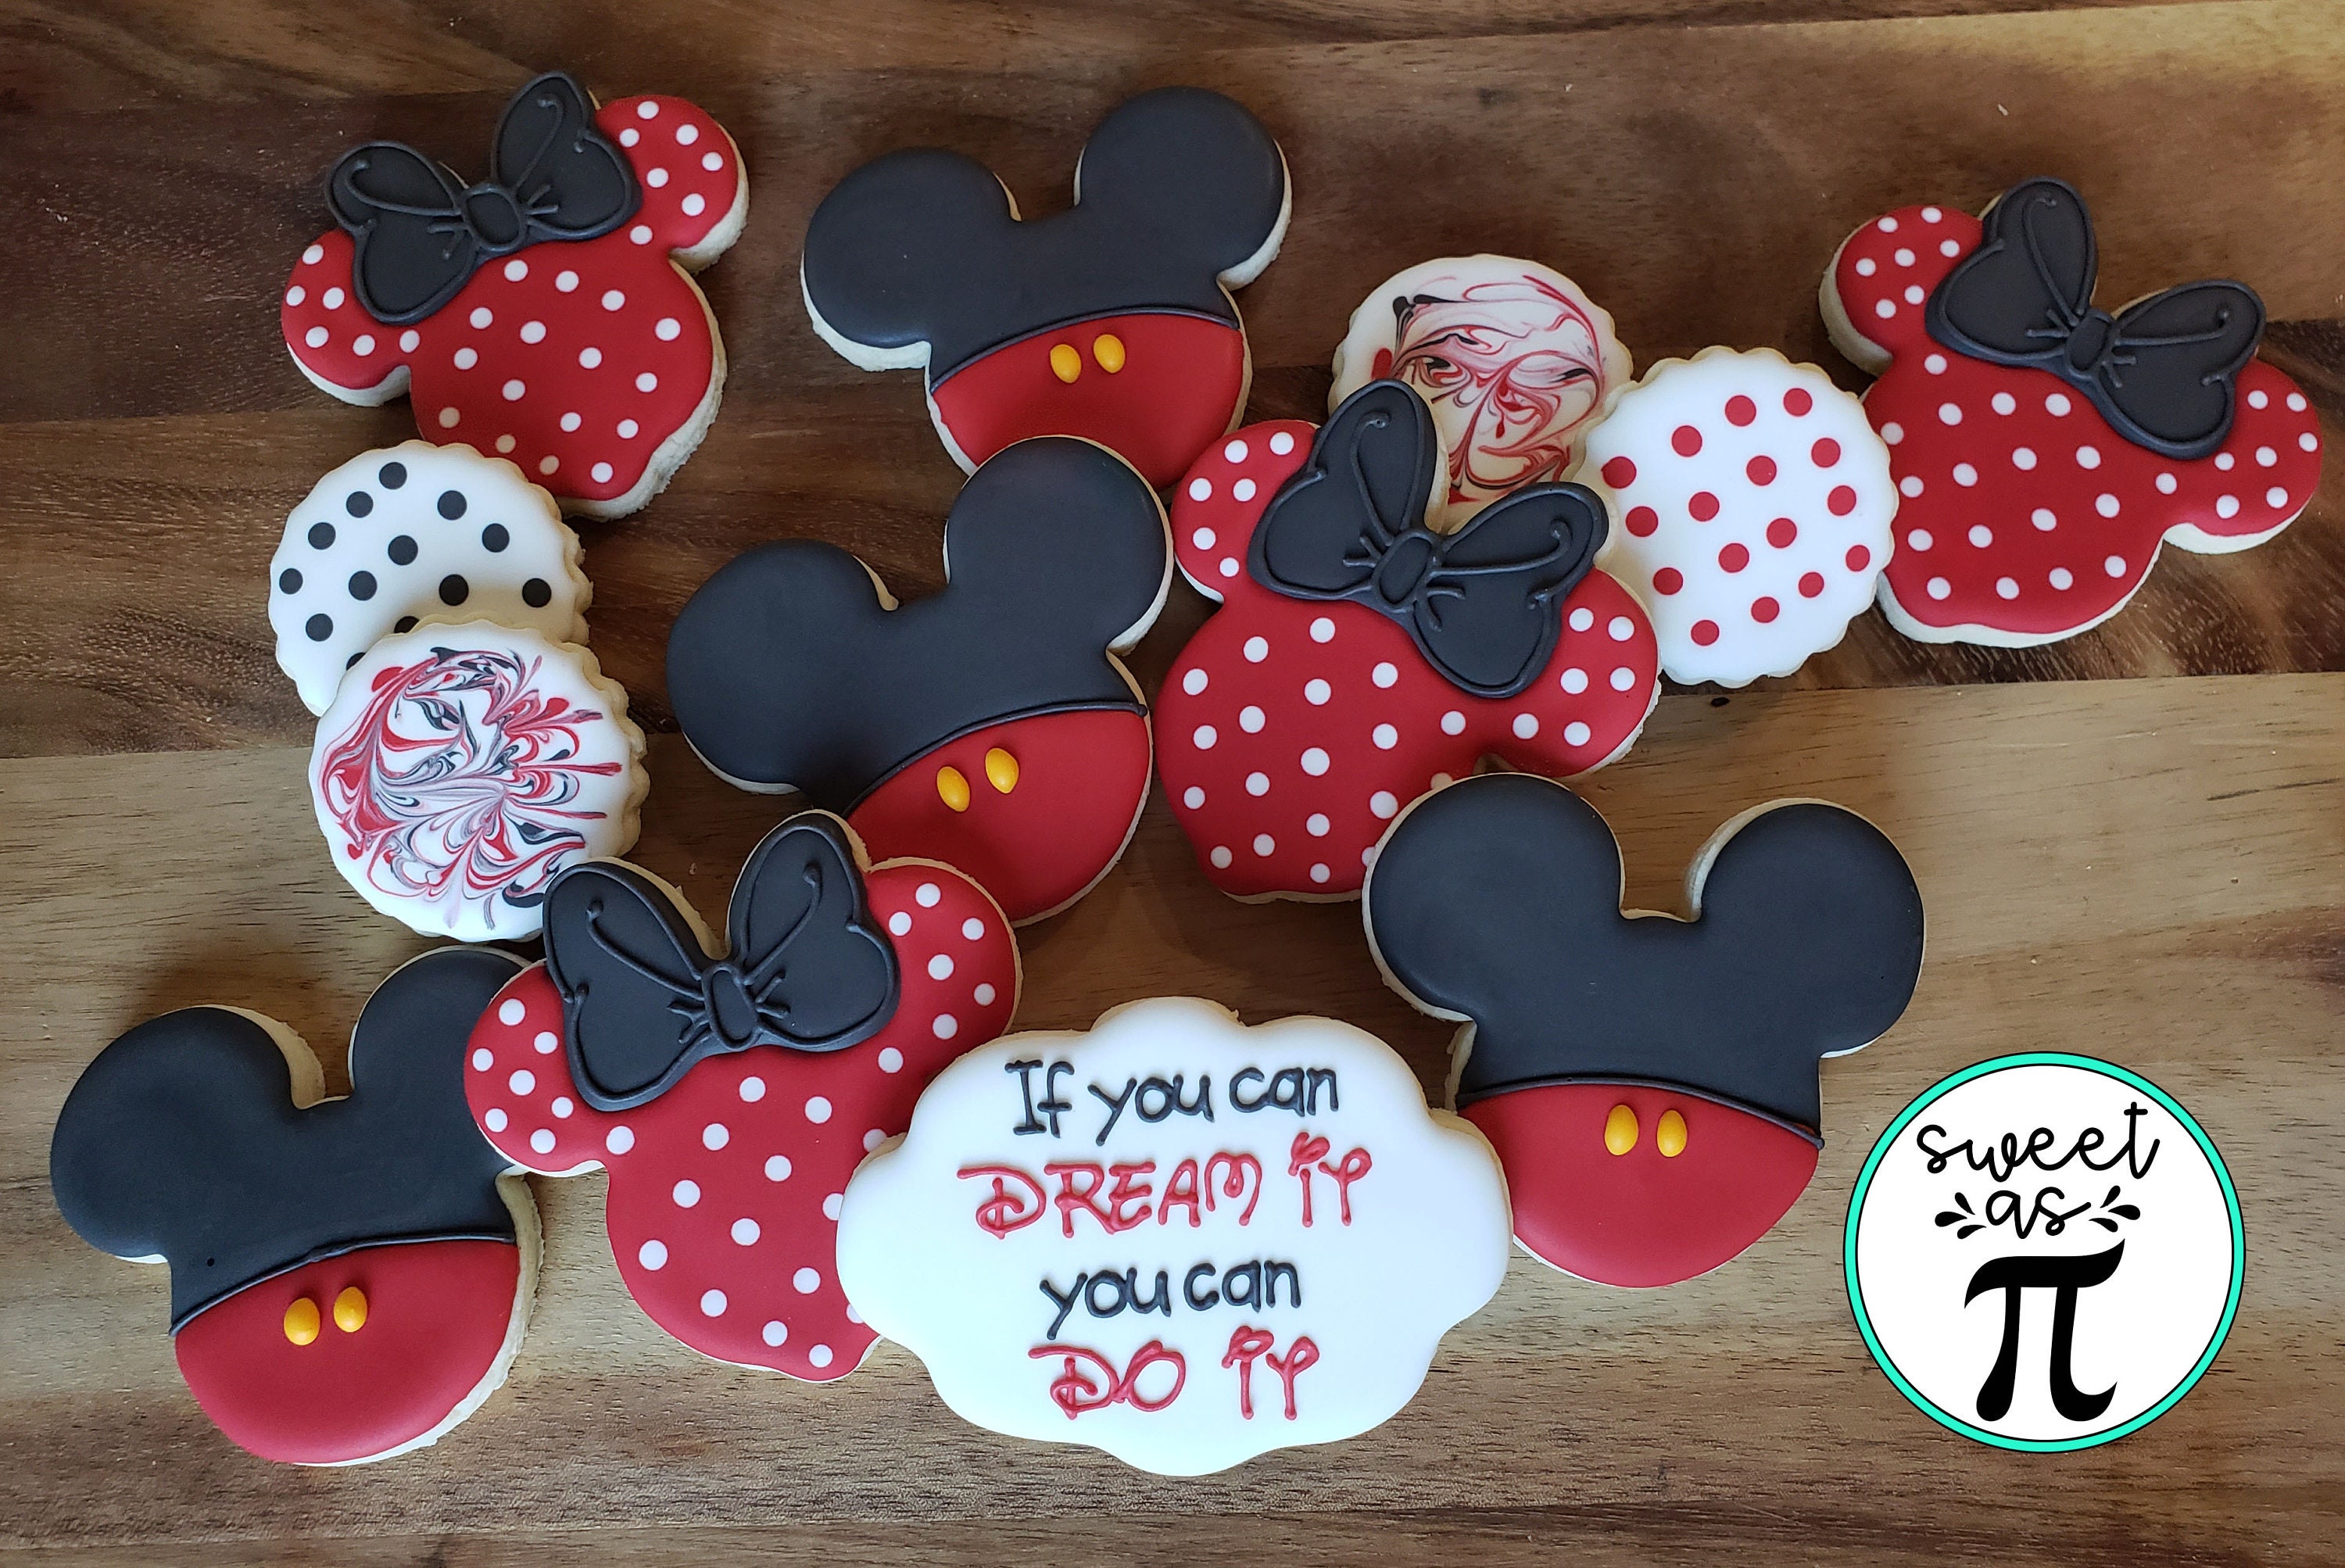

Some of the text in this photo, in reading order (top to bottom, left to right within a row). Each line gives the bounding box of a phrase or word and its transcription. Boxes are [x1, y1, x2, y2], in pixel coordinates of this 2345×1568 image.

[1004, 1058, 1340, 1146] If you can
[957, 1151, 1263, 1238] DREAM
[1039, 1259, 1302, 1340] you can
[1029, 1340, 1187, 1420] DO
